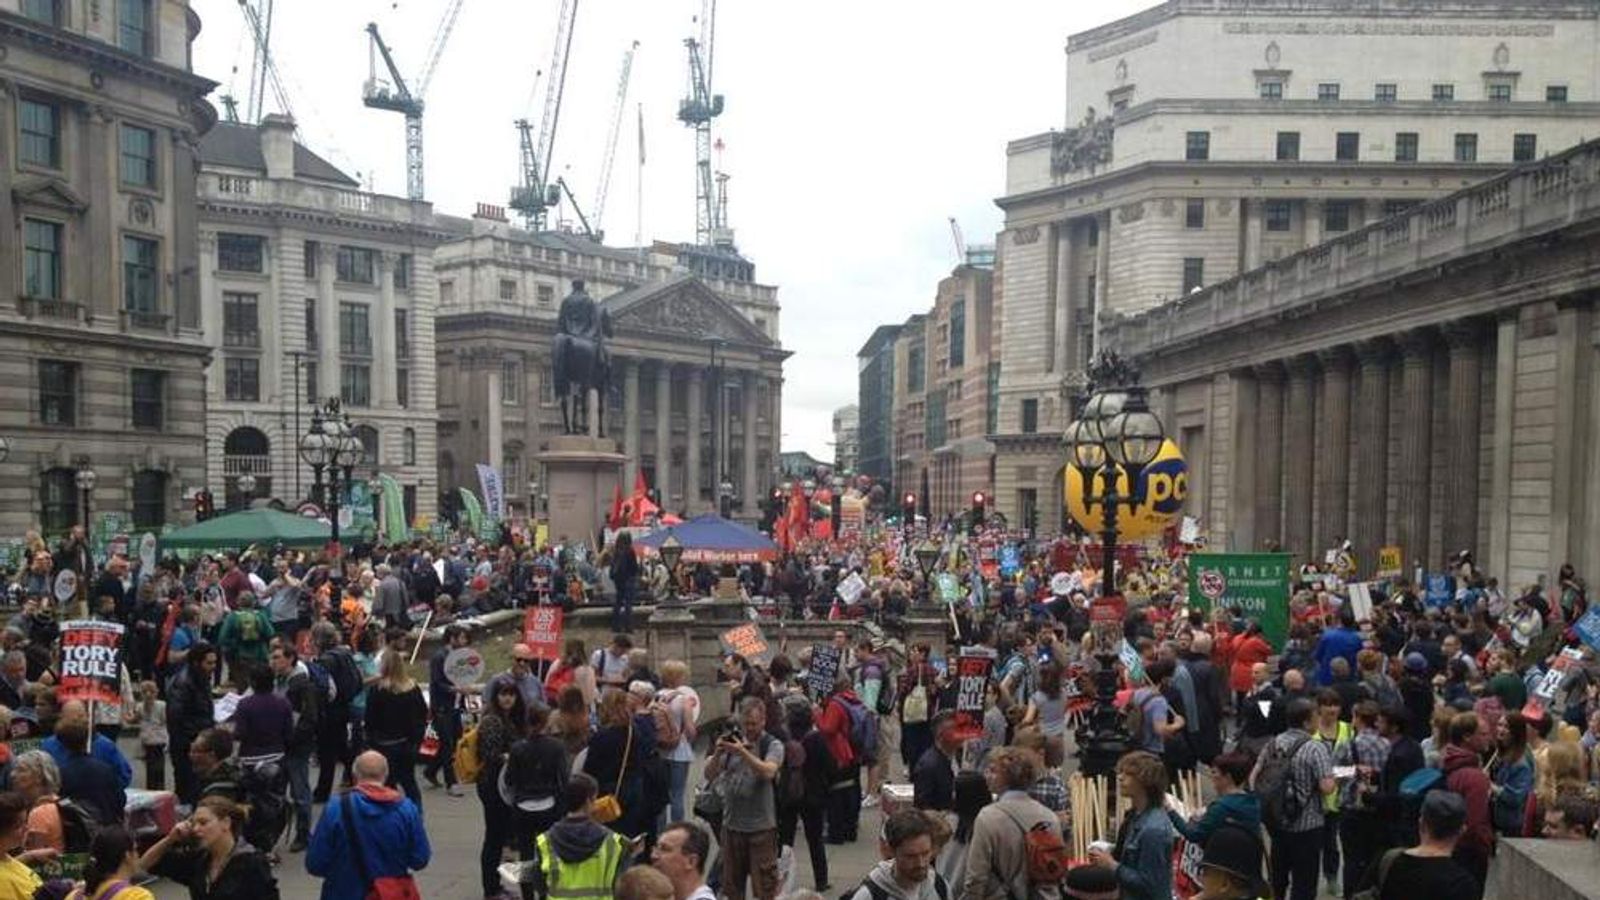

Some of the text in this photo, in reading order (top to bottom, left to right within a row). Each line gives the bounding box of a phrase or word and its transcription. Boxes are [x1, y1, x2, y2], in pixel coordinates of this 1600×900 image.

[62, 645, 119, 662] TORY
[62, 661, 117, 678] RULE
[960, 676, 988, 692] TORY
